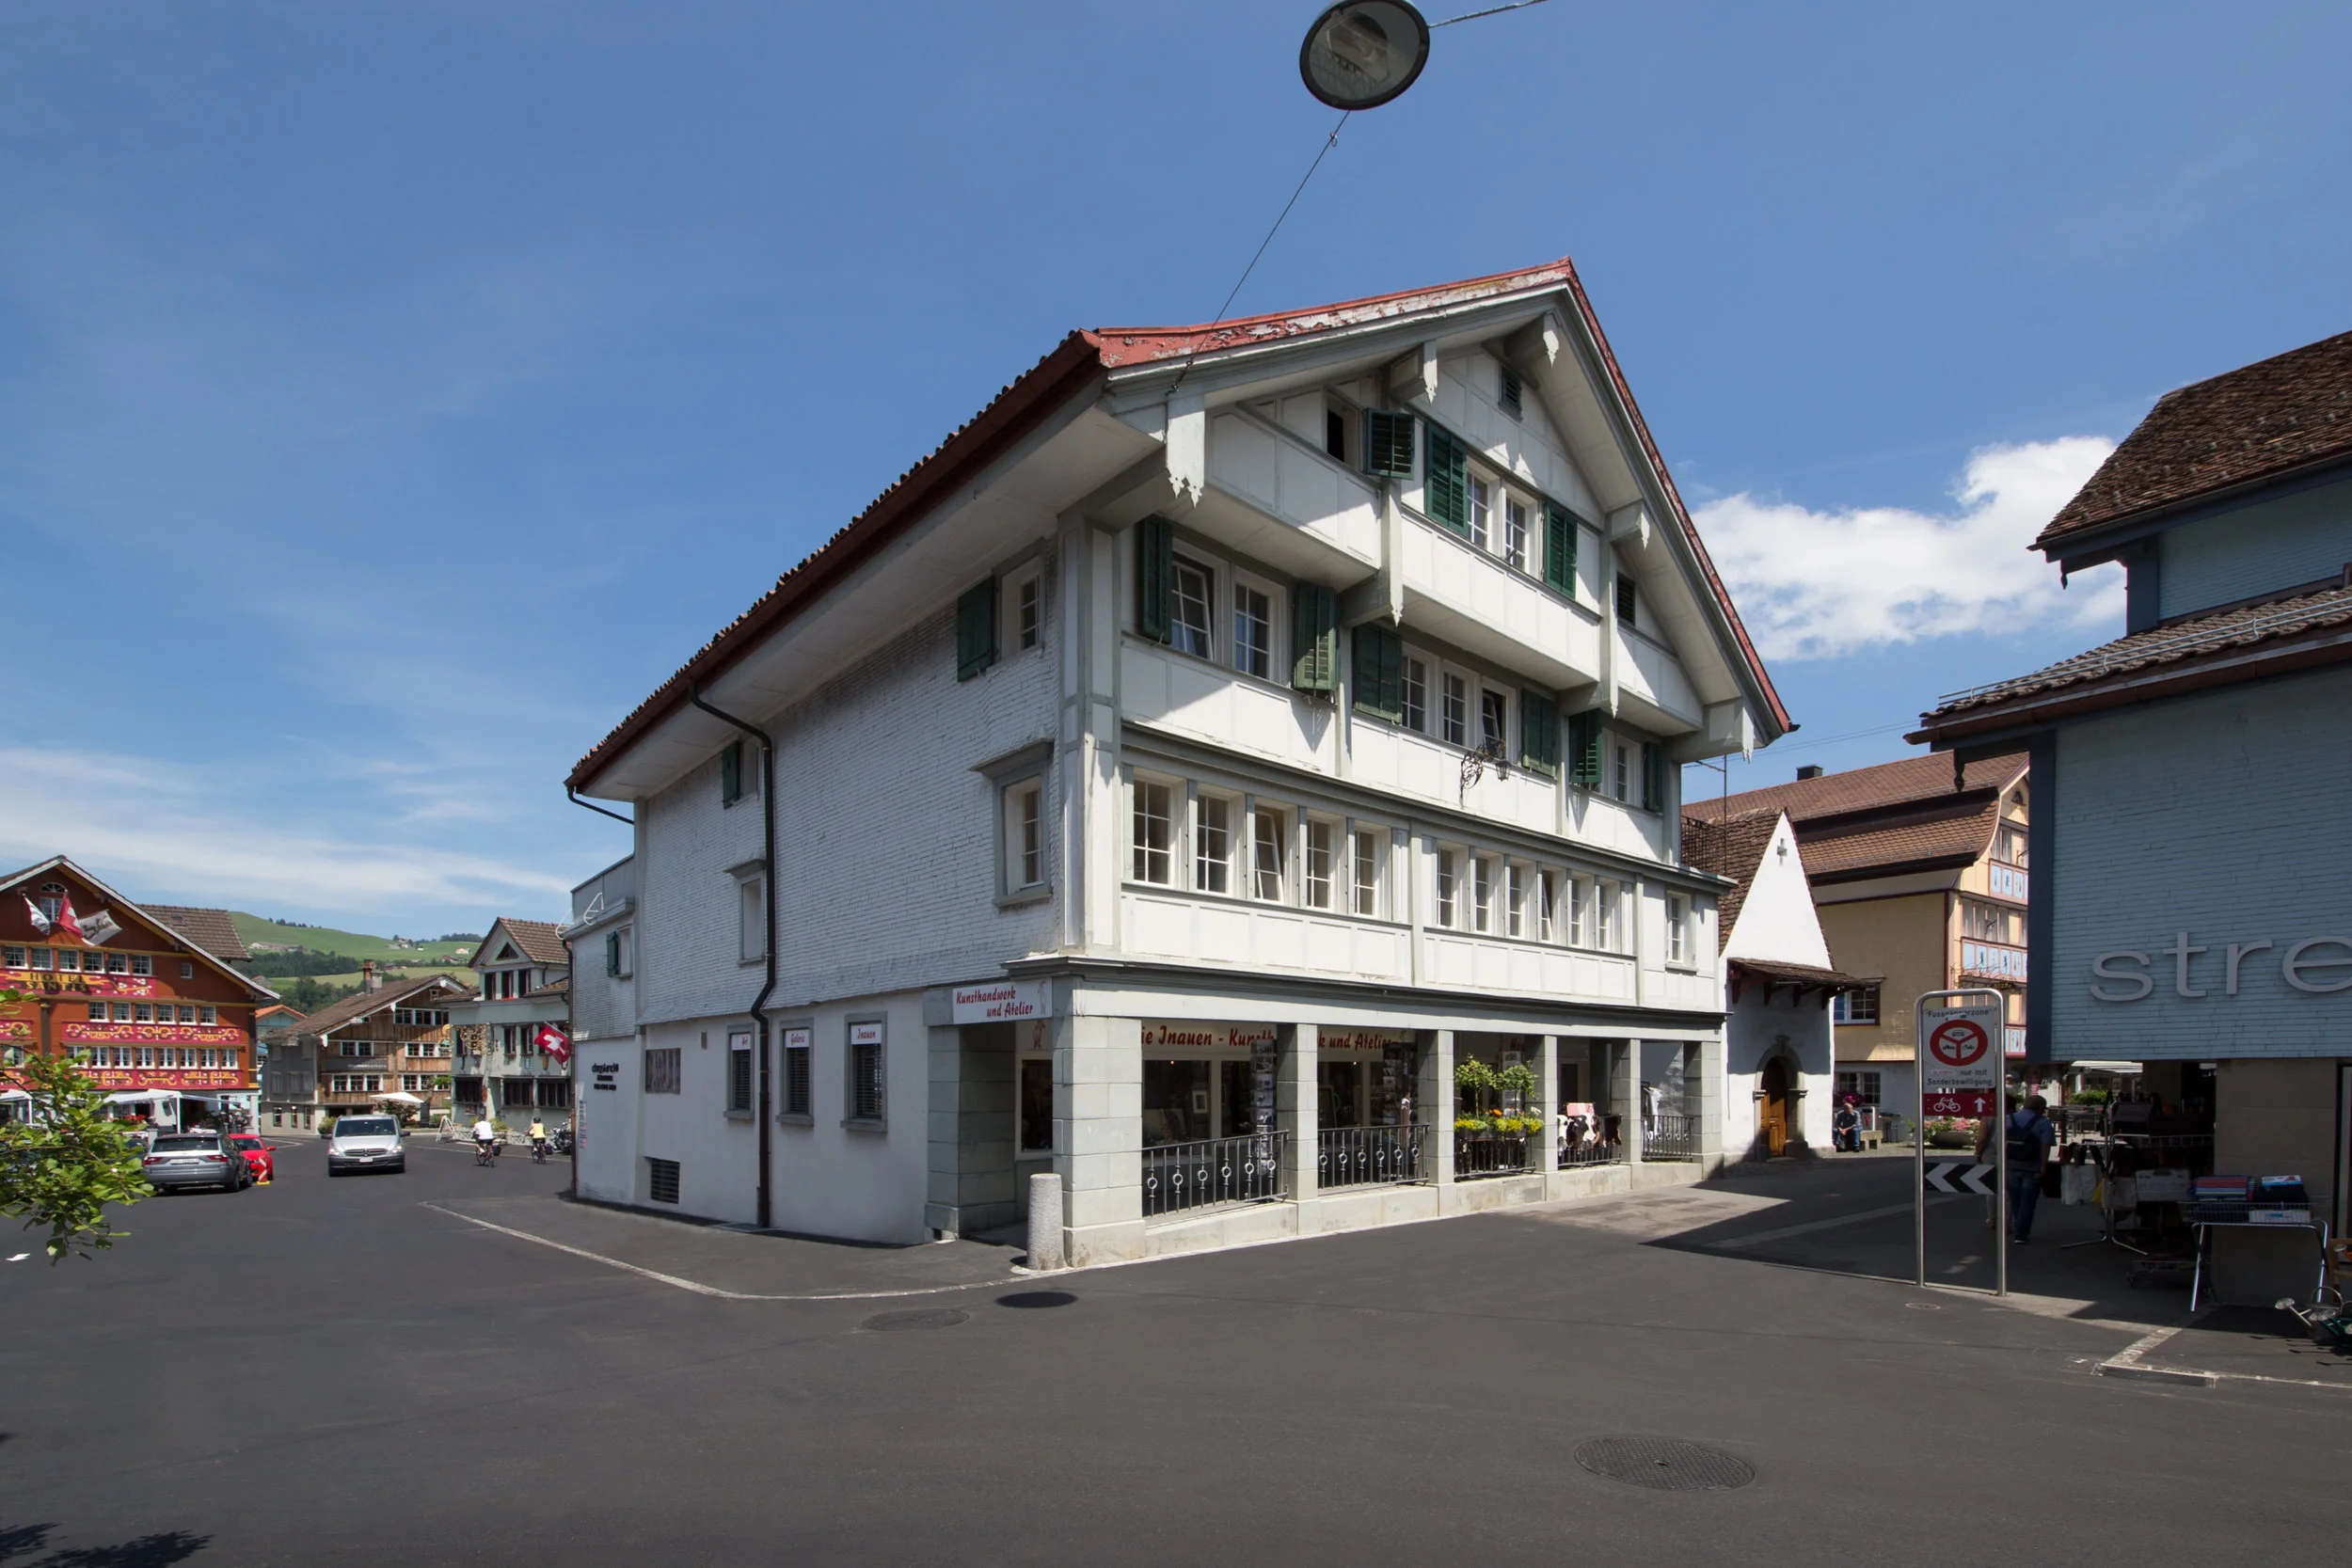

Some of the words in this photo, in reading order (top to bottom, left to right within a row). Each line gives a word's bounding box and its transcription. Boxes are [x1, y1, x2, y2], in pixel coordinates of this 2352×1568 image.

[2090, 931, 2352, 1002] stre
[29, 972, 83, 982] HOTEL
[956, 985, 1016, 1005] Kunsthandwerk
[986, 1003, 1002, 1018] und
[1004, 1001, 1034, 1019] Atelier
[1329, 1031, 1351, 1049] und
[1927, 1077, 1993, 1087] Sonderbewilligung
